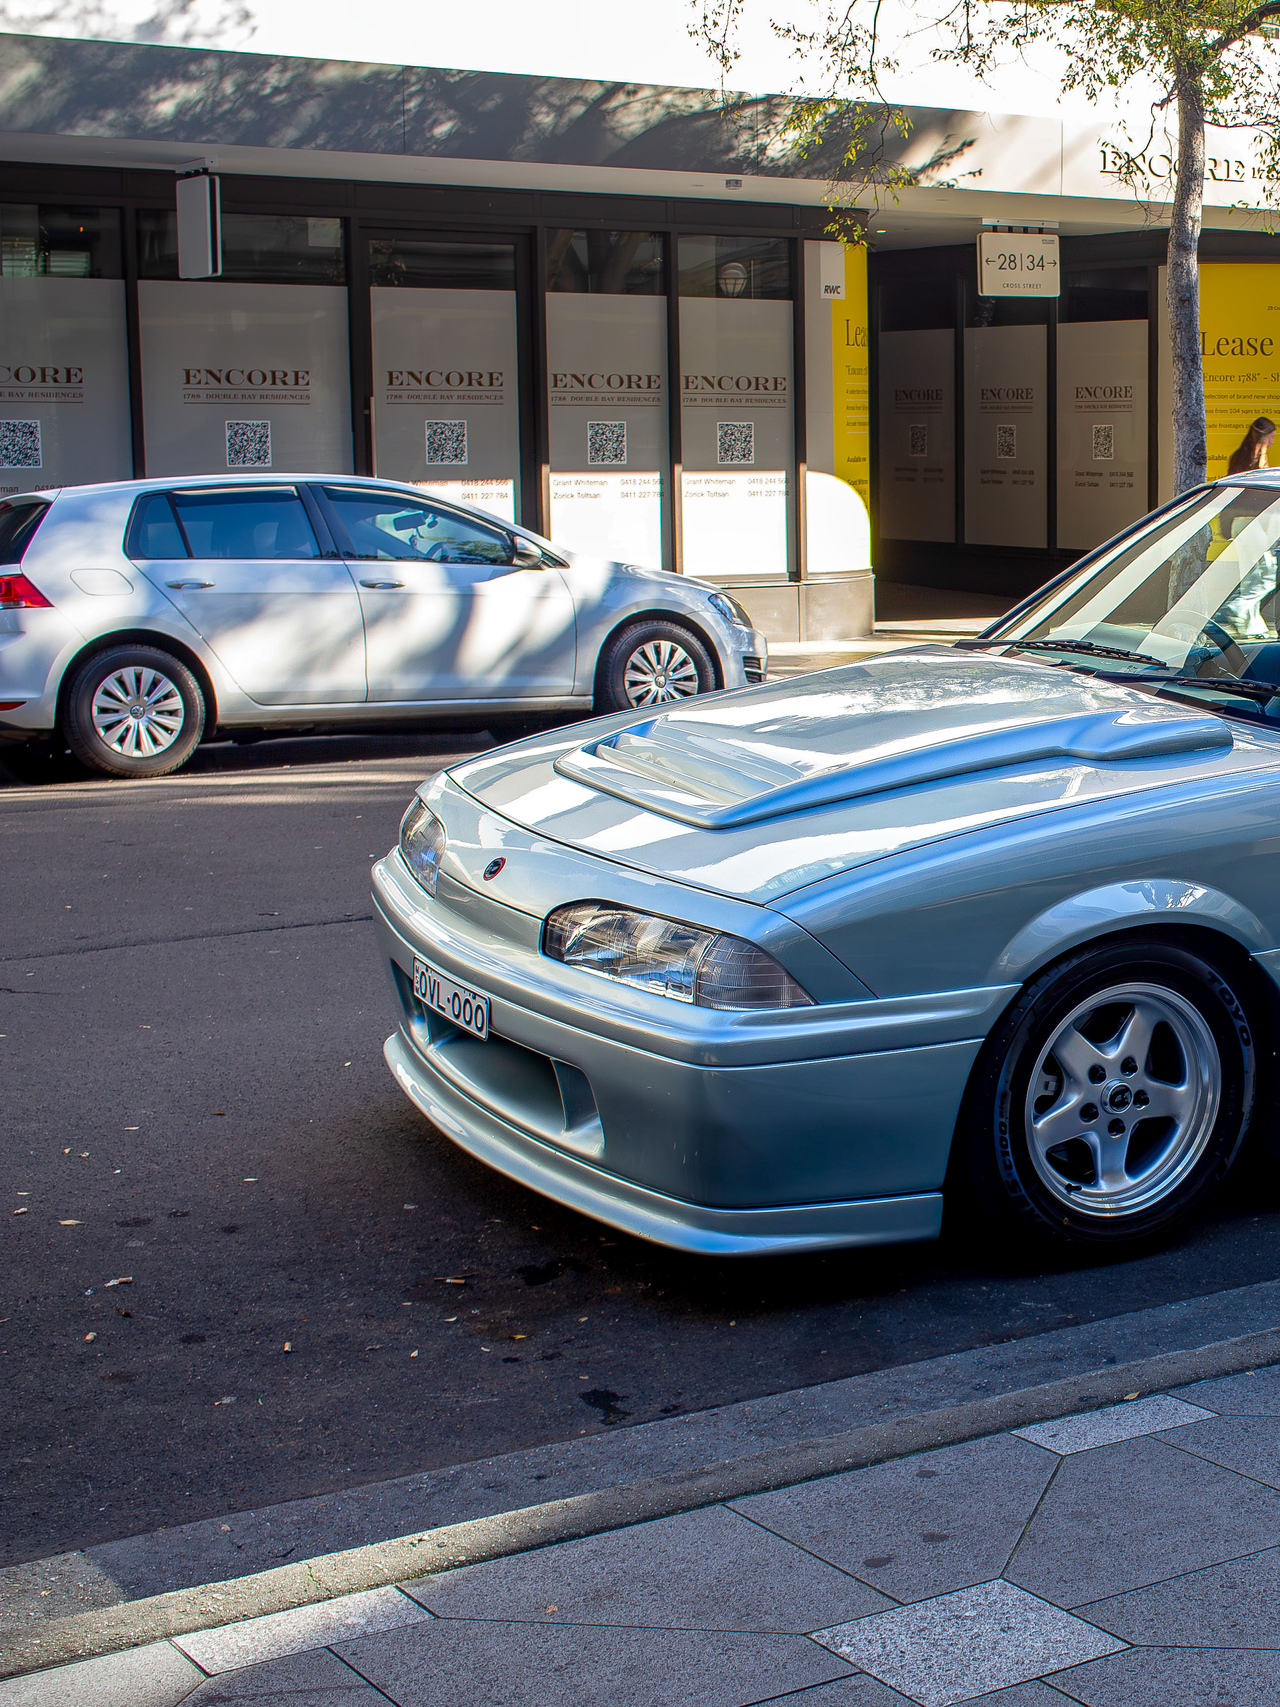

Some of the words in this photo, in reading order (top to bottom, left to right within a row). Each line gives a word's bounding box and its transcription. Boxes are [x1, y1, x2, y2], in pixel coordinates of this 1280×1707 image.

[1099, 150, 1246, 184] ENCRE
[824, 285, 841, 294] RWC
[1200, 331, 1274, 356] Lease
[182, 369, 310, 386] ENCORE
[386, 370, 504, 387] ENCORE
[551, 373, 661, 389] ENCORE
[683, 376, 786, 391] ENCORE
[895, 389, 943, 401] ENCORE
[981, 388, 1033, 400] ENCORE
[1075, 386, 1132, 399] ENCORE
[1206, 970, 1253, 1048] TOYO
